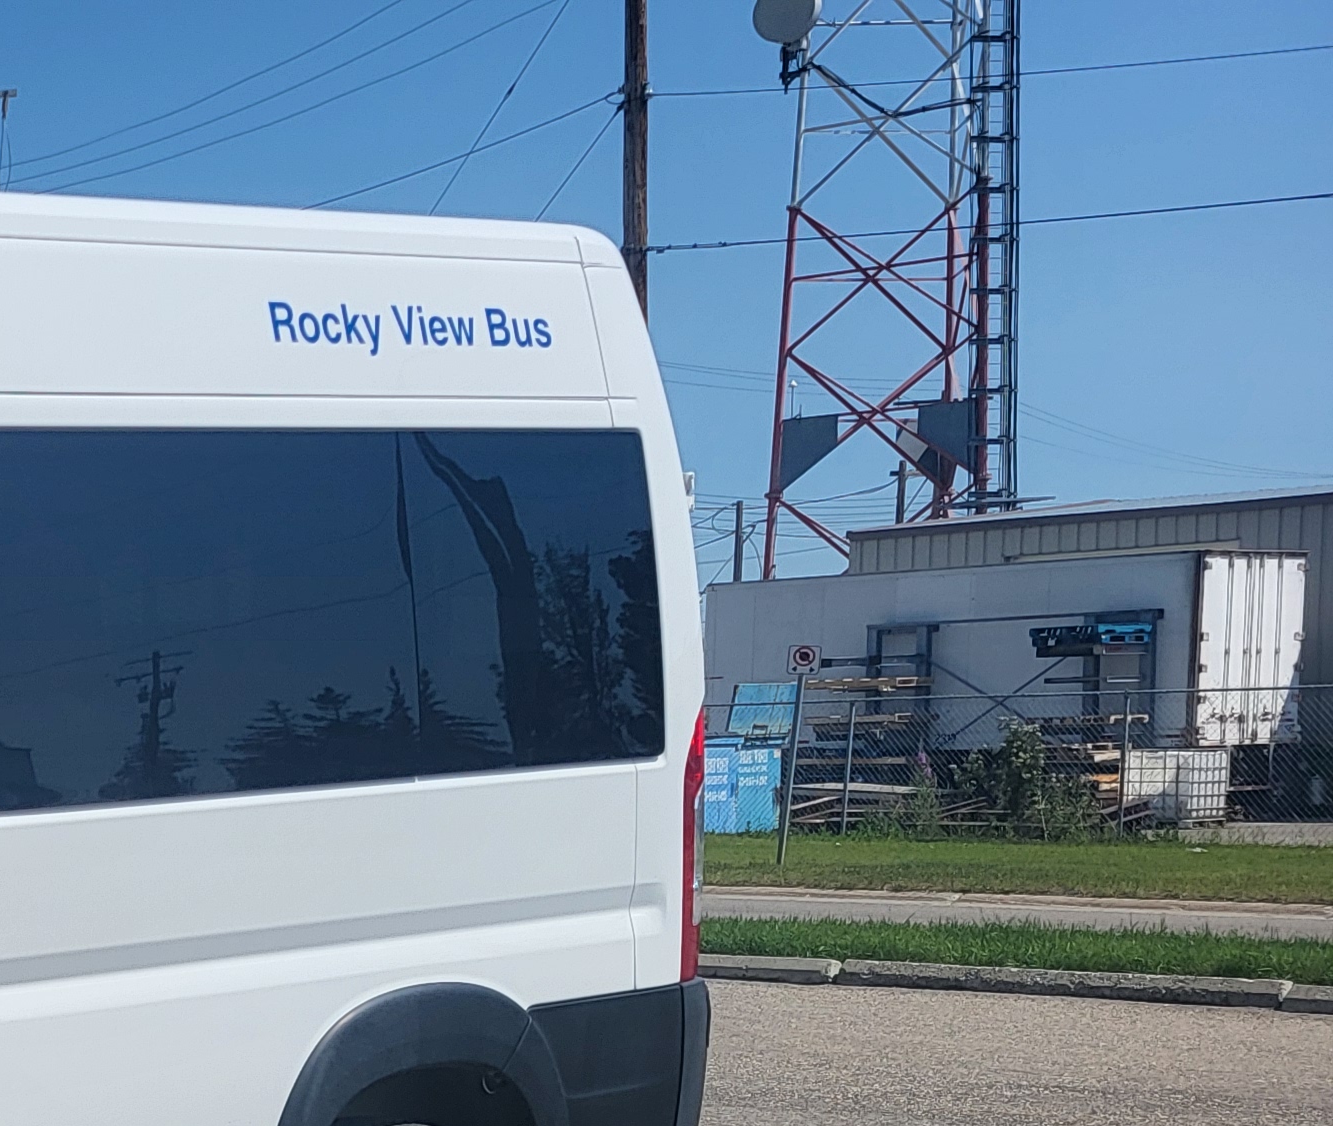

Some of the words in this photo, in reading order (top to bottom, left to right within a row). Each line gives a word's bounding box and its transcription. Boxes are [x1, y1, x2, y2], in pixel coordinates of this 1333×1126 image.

[268, 301, 380, 356] Rocky
[391, 305, 474, 346] View
[484, 307, 552, 348] Bus
